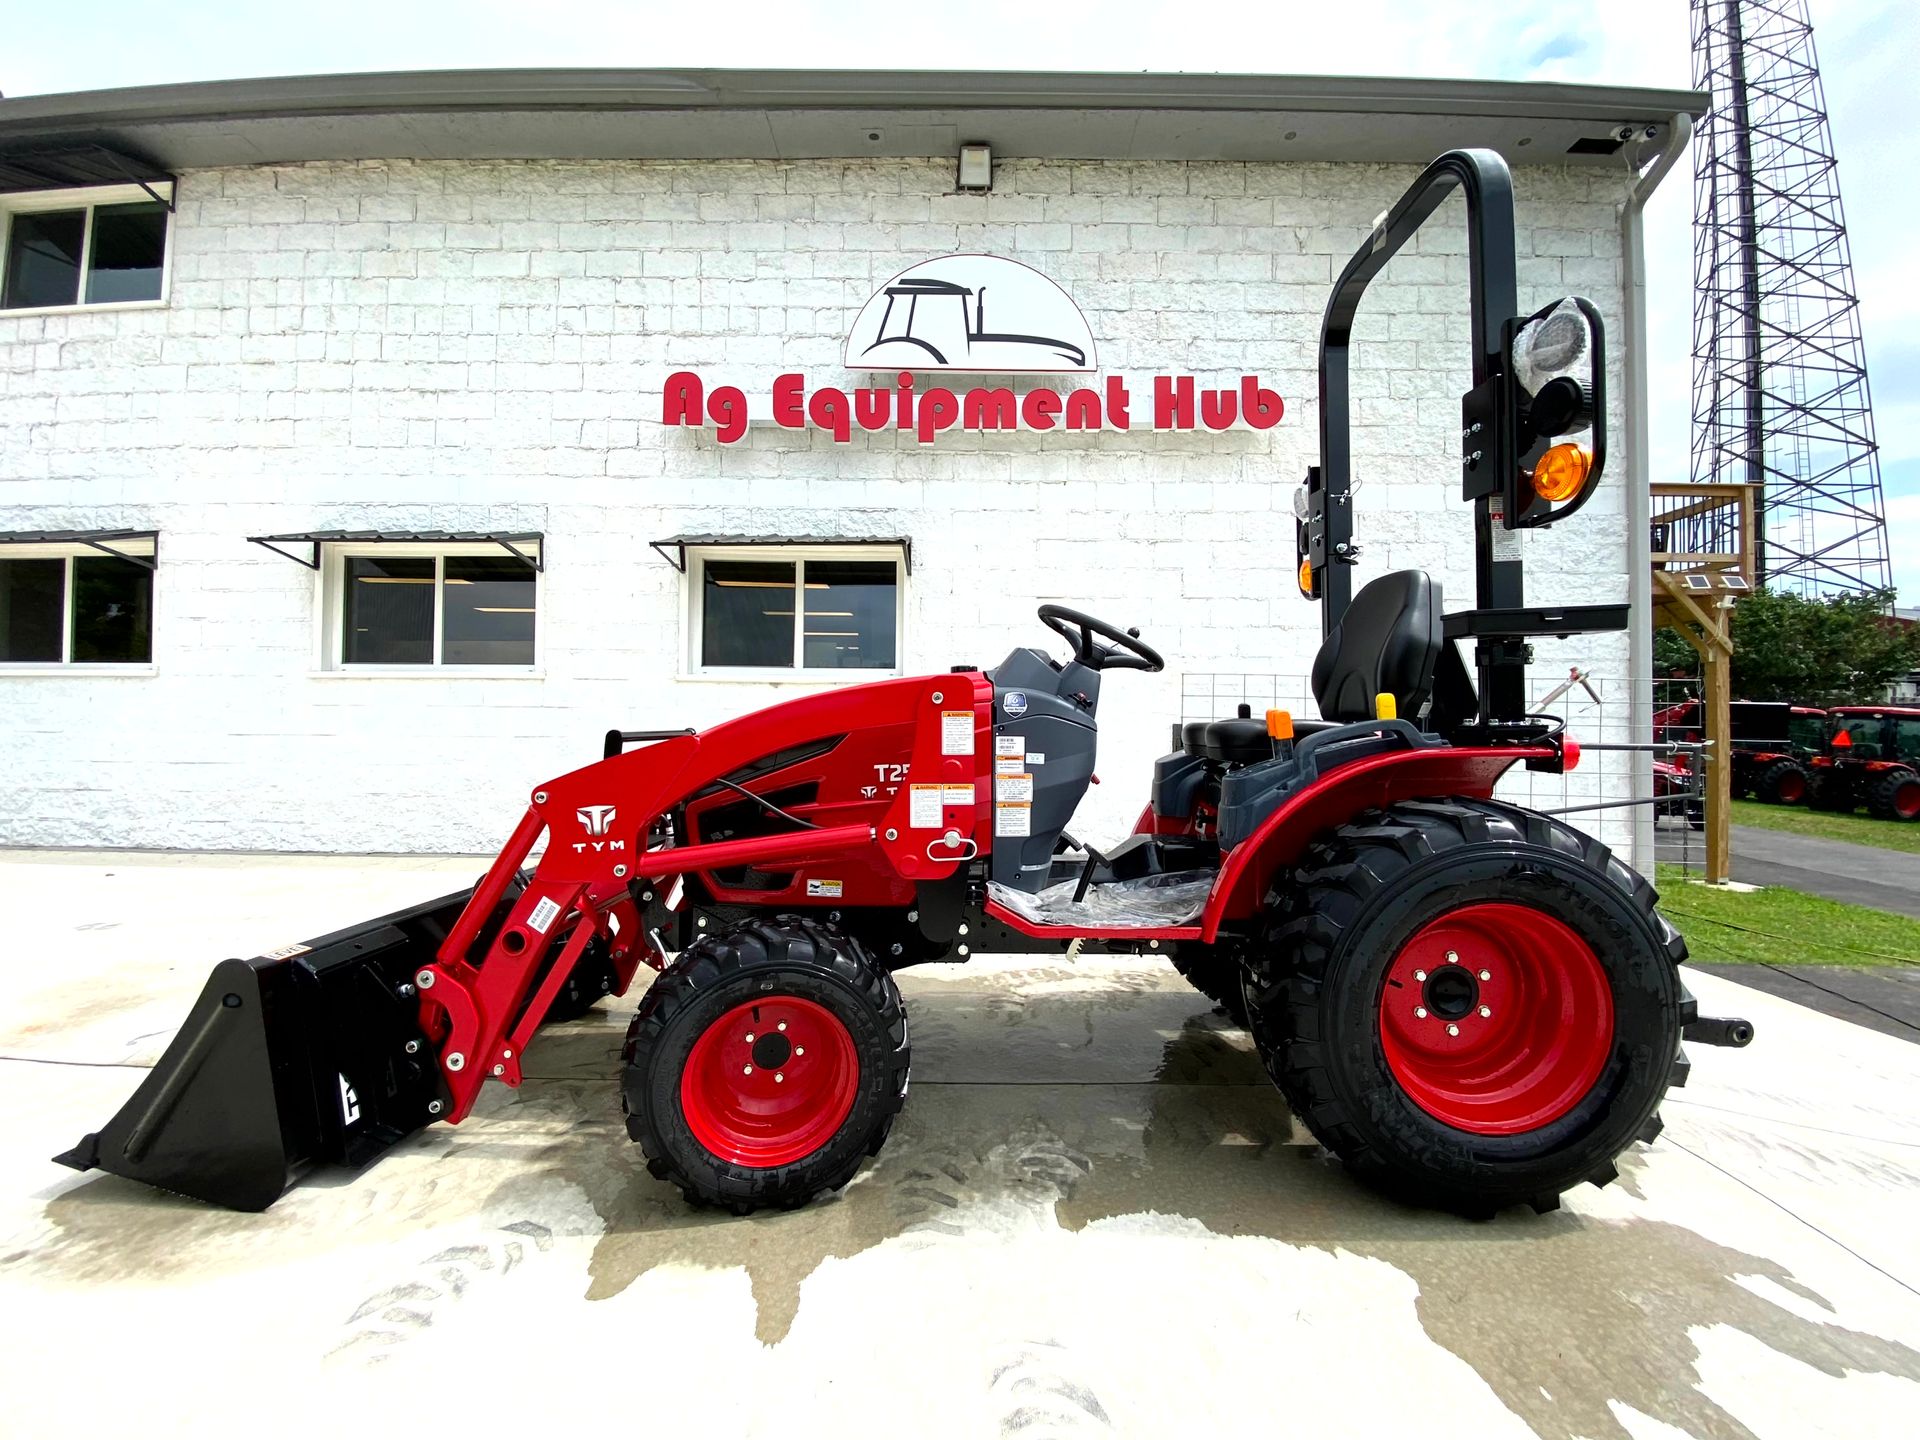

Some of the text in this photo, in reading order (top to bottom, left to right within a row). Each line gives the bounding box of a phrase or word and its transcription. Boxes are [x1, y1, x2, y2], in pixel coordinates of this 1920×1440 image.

[663, 371, 1283, 443] Ag Equipment Hub
[572, 840, 625, 853] TYM
